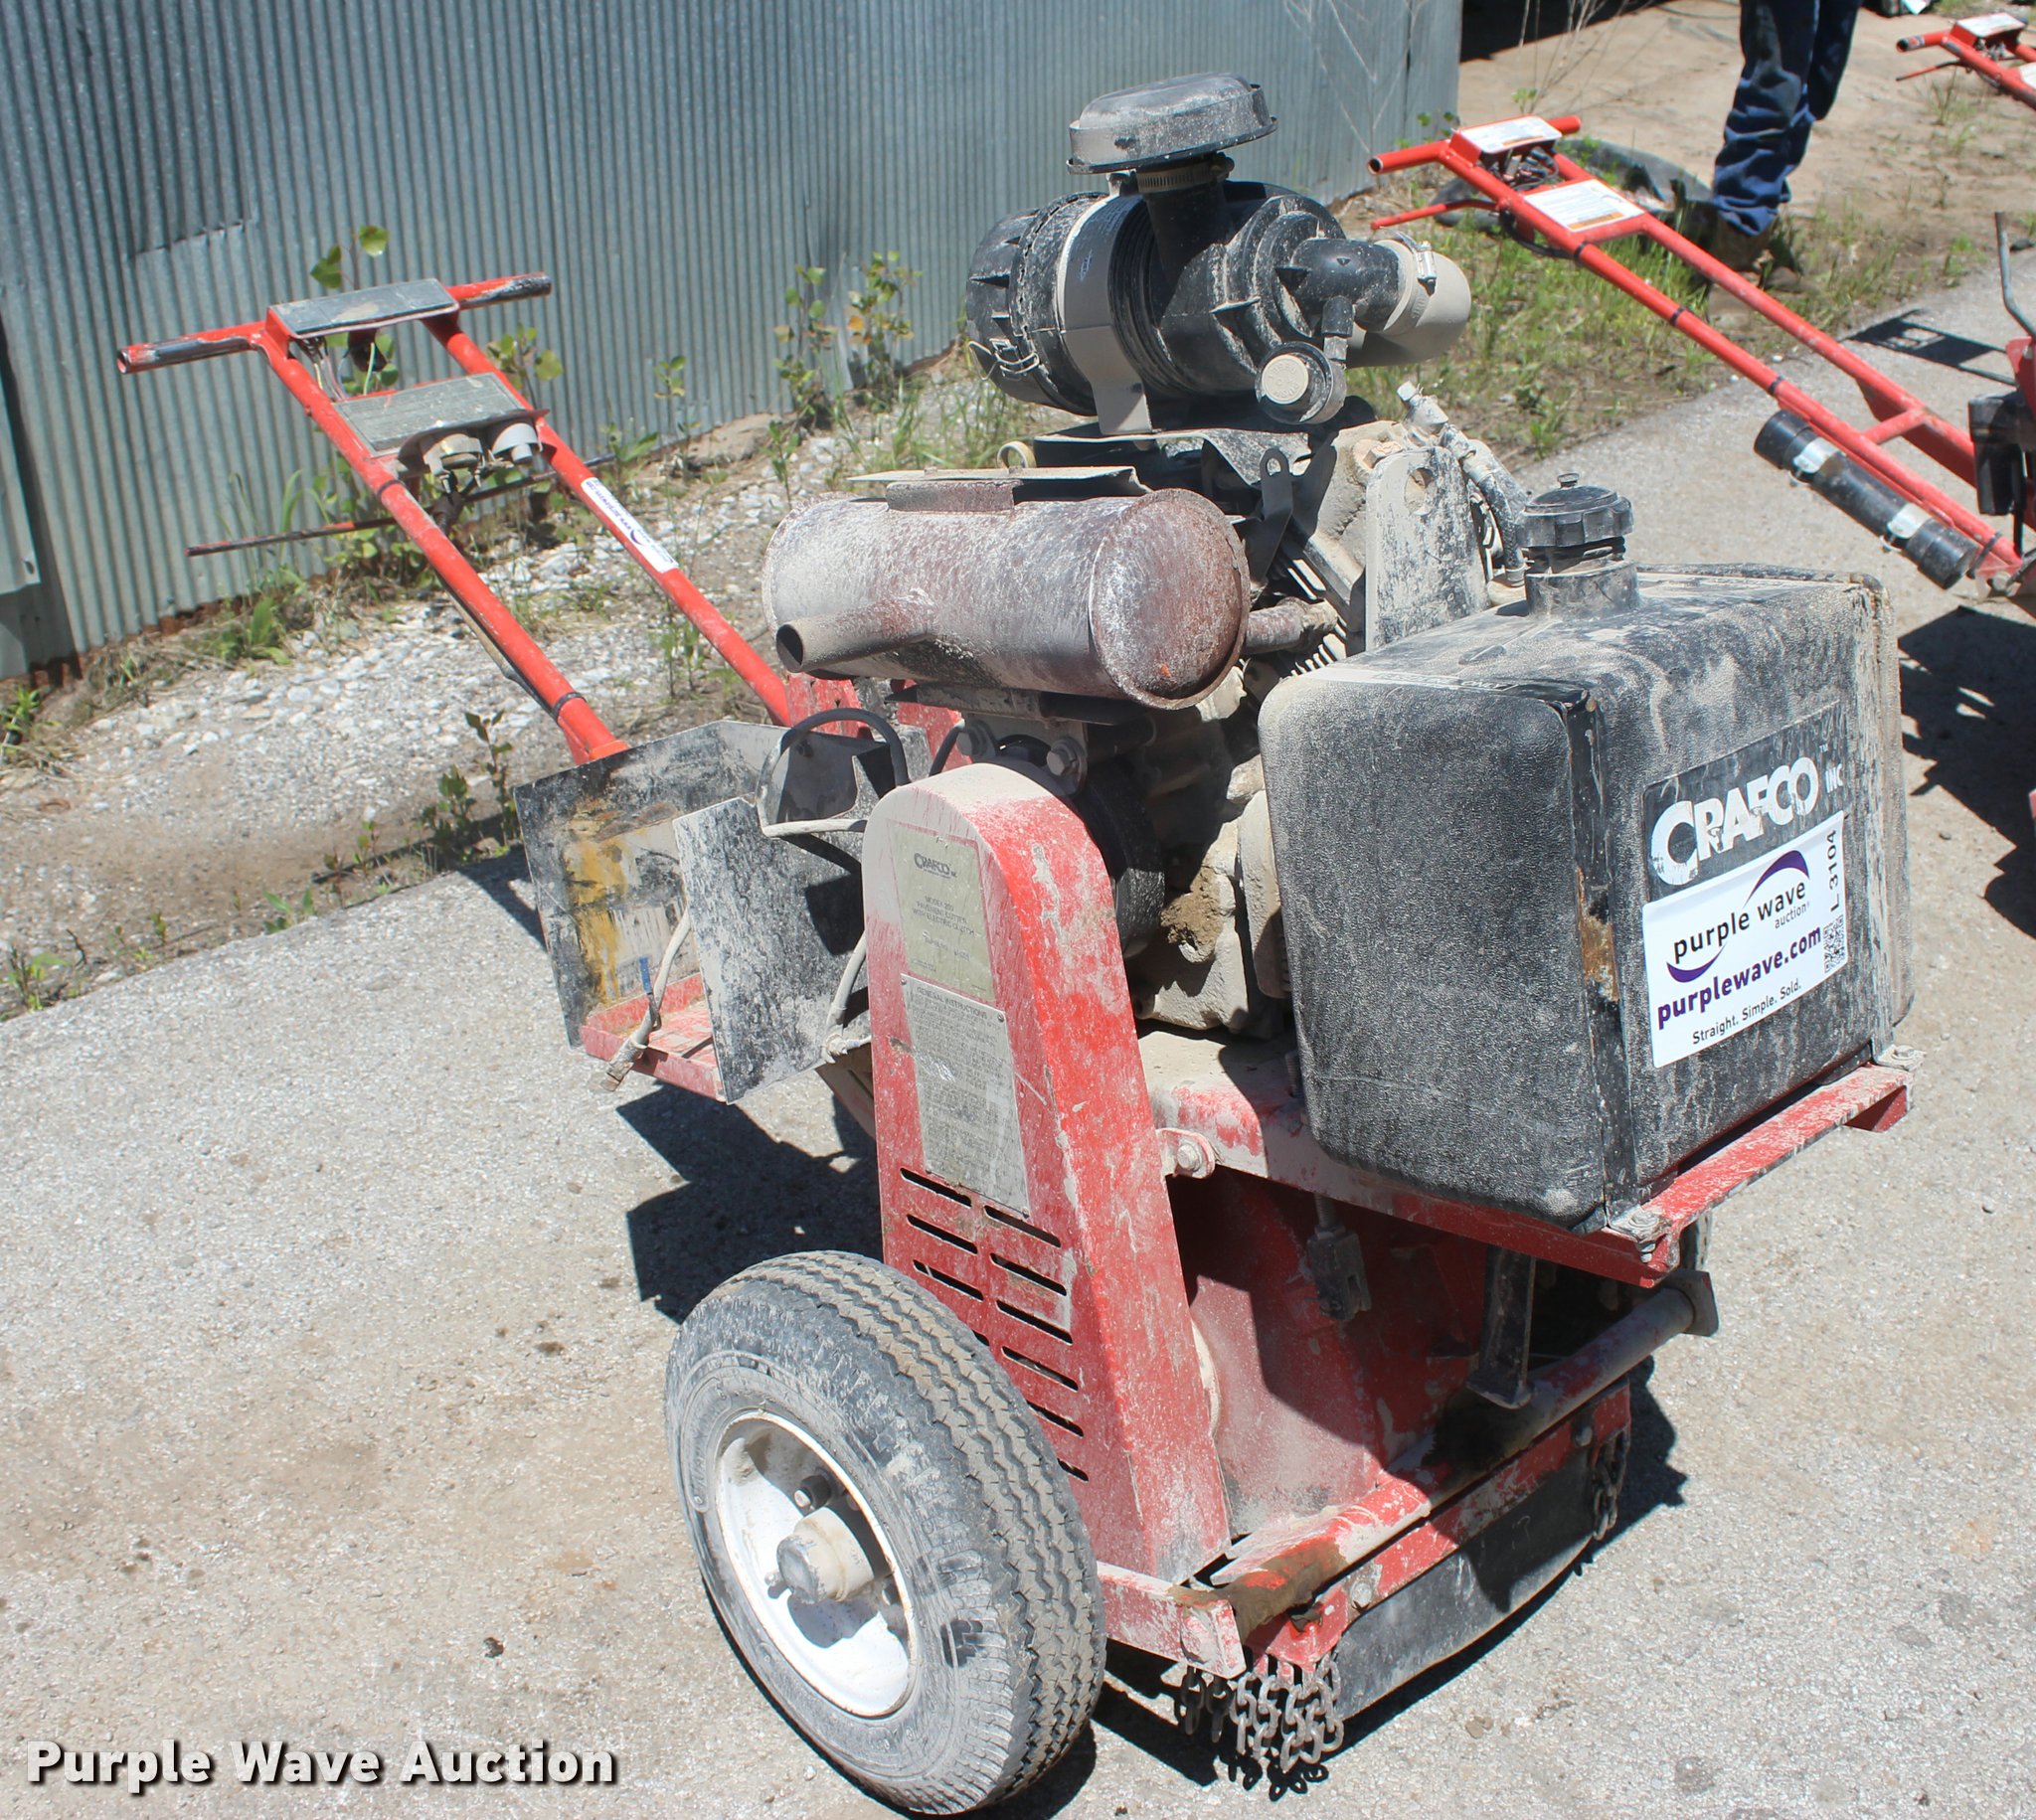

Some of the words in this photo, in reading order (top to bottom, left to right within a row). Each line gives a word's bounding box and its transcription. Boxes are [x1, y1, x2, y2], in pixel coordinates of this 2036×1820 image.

[1650, 756, 1819, 886] CRAFCO
[1673, 911, 1750, 964] purple
[1757, 881, 1806, 921] wave
[1774, 903, 1807, 929] auction
[1657, 926, 1822, 1030] purplewave.com
[1692, 1015, 1739, 1045] Straight.
[1742, 994, 1778, 1021] Simple.
[1780, 978, 1801, 1000] Sold.
